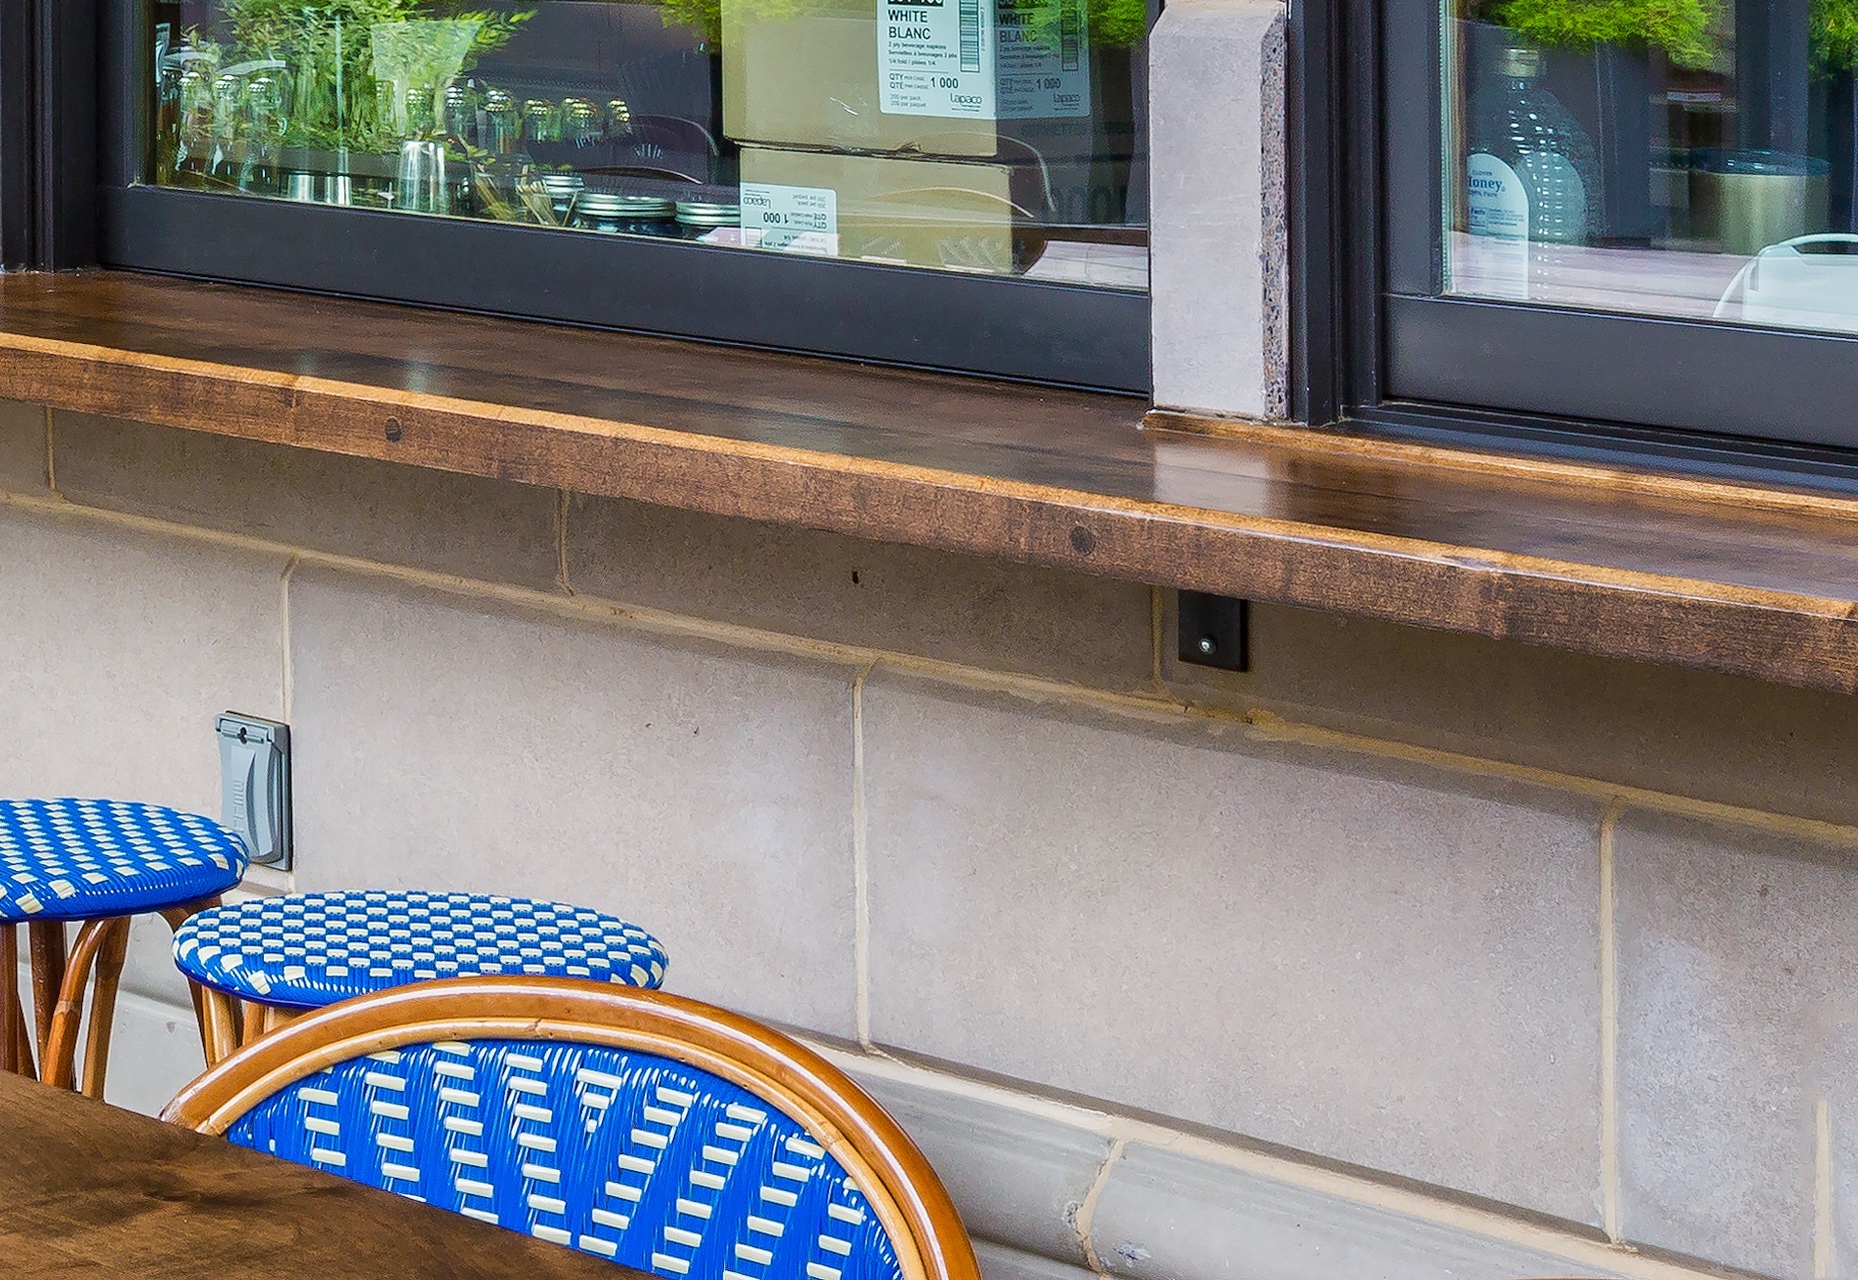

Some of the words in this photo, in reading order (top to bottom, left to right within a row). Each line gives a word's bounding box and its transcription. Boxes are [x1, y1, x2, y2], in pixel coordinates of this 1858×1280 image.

[888, 9, 928, 22] WHITE
[888, 26, 931, 40] BLANC
[889, 73, 904, 81] QTY
